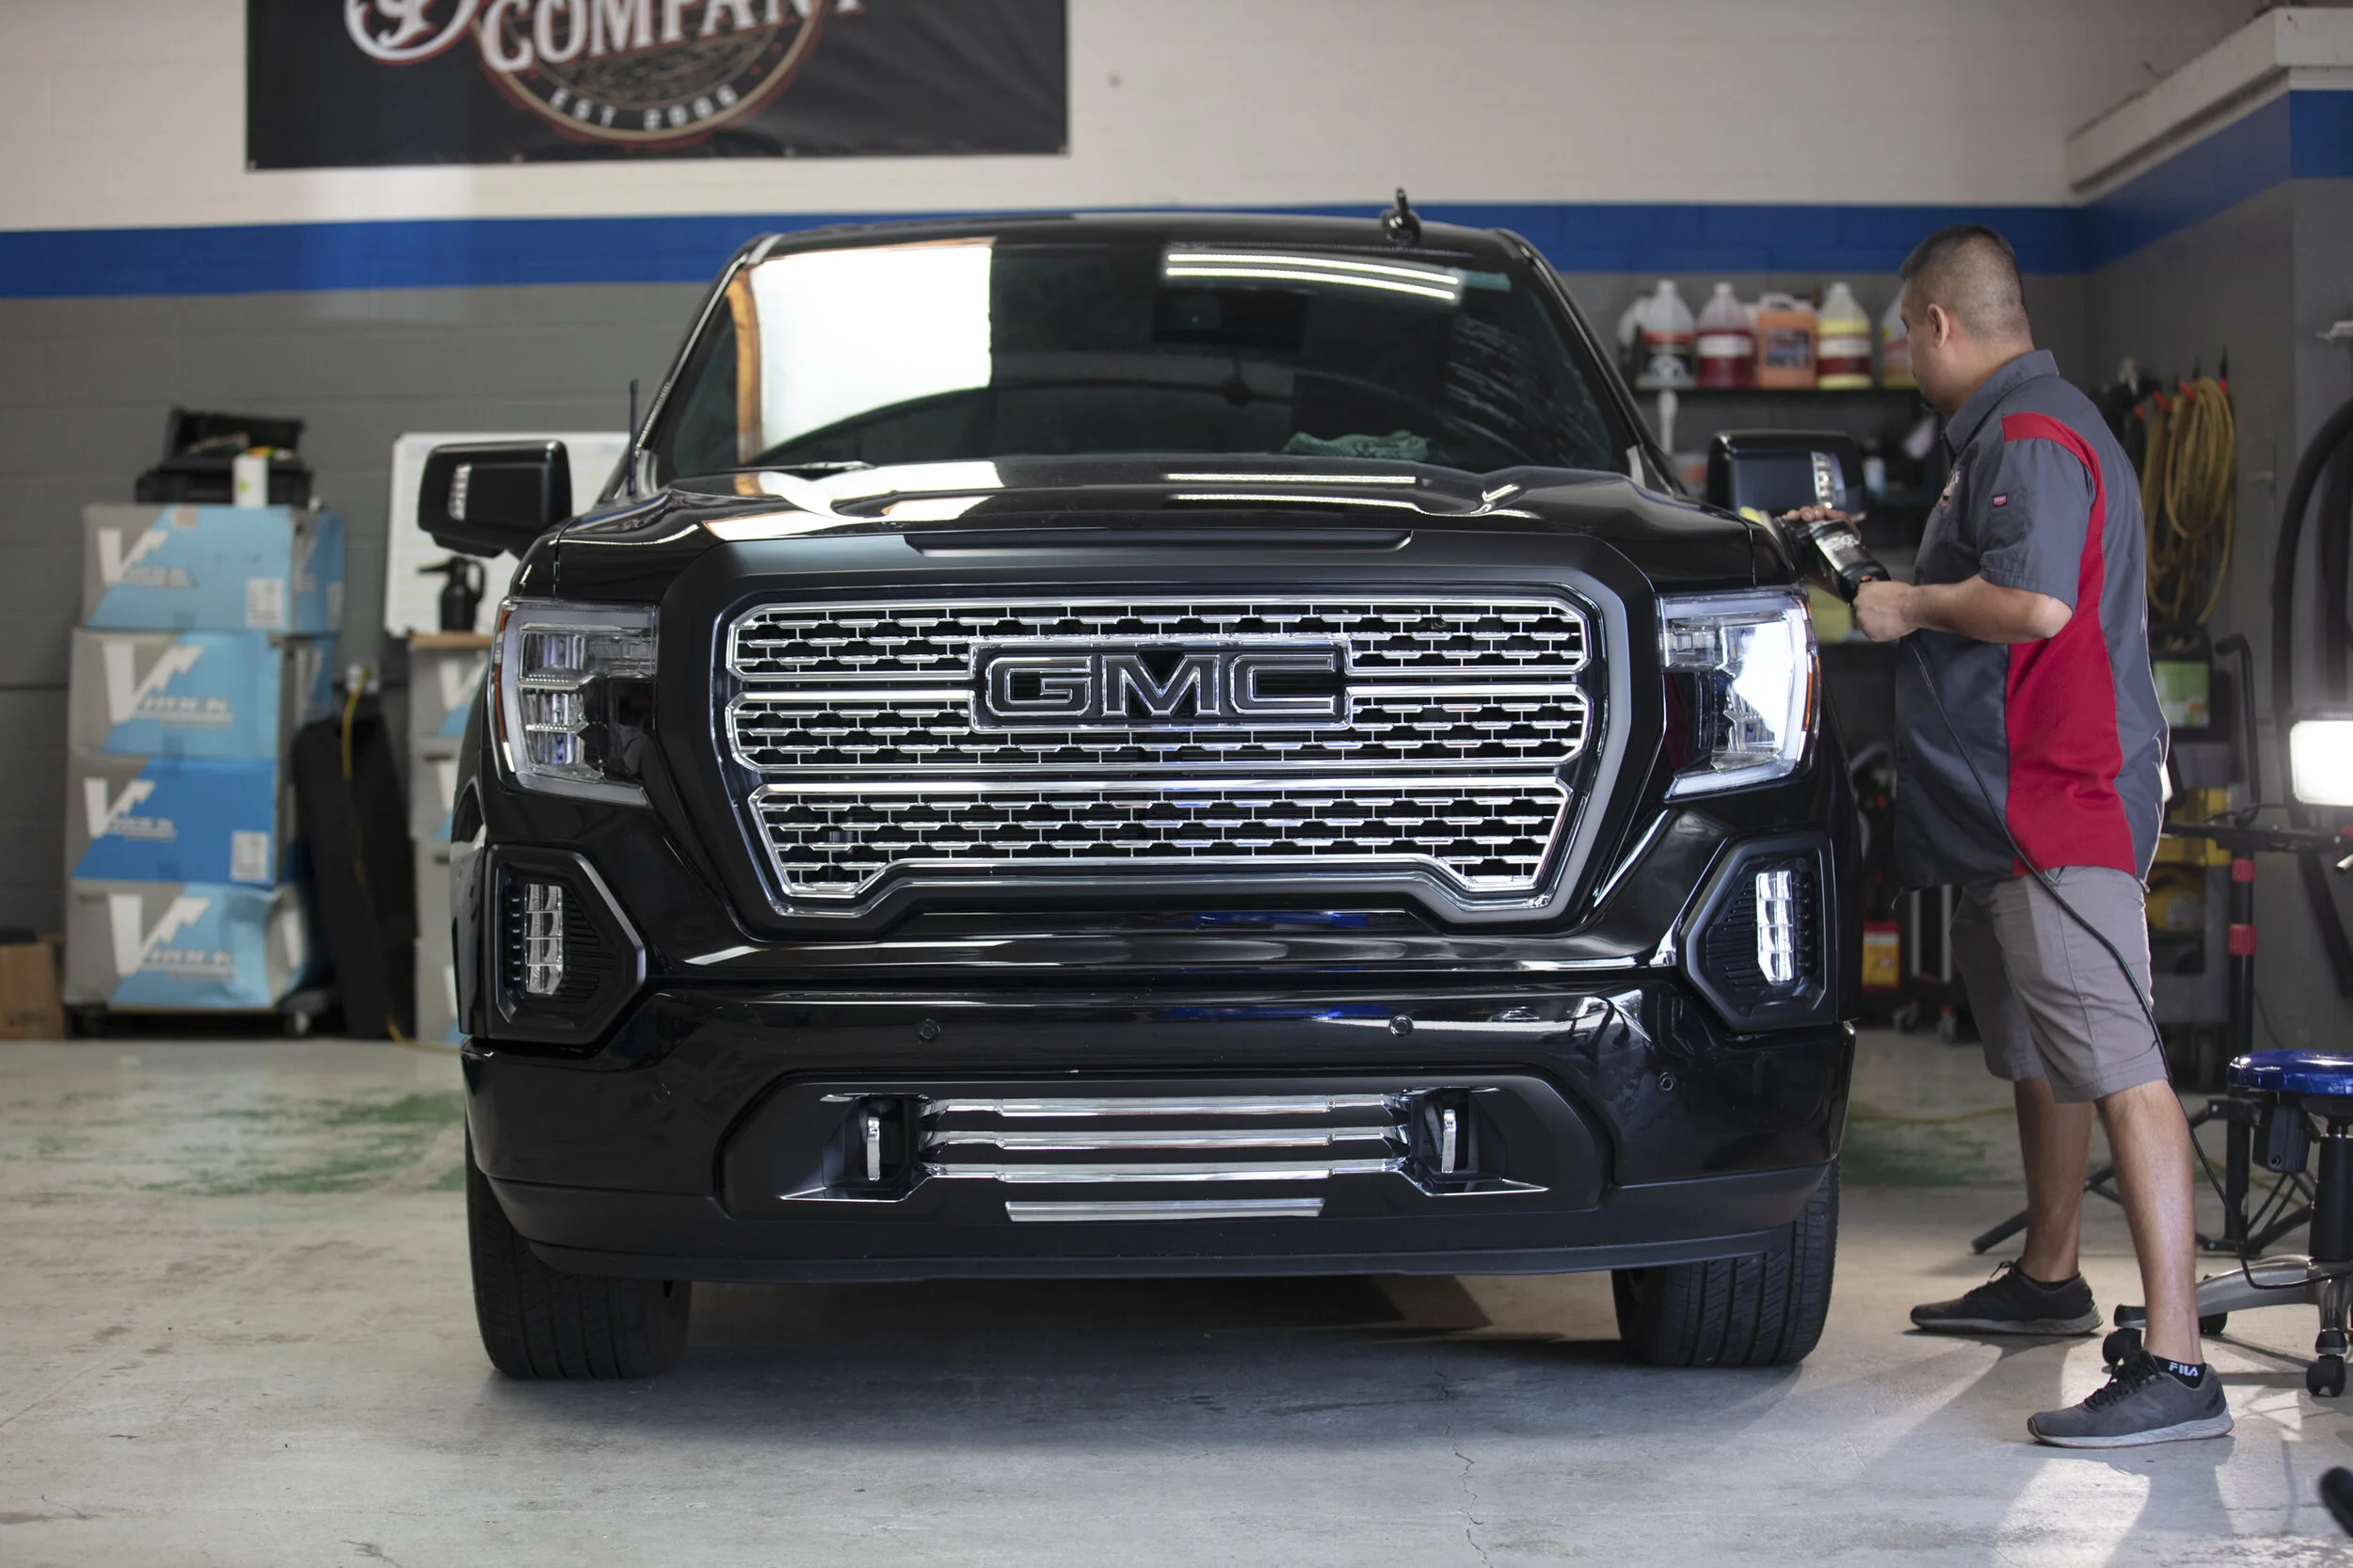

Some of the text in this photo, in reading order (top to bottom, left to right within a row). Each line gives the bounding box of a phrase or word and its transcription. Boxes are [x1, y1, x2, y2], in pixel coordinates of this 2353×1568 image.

[482, 0, 863, 72] COMPA
[986, 654, 1337, 716] GMC
[2169, 1362, 2199, 1377] FILA
